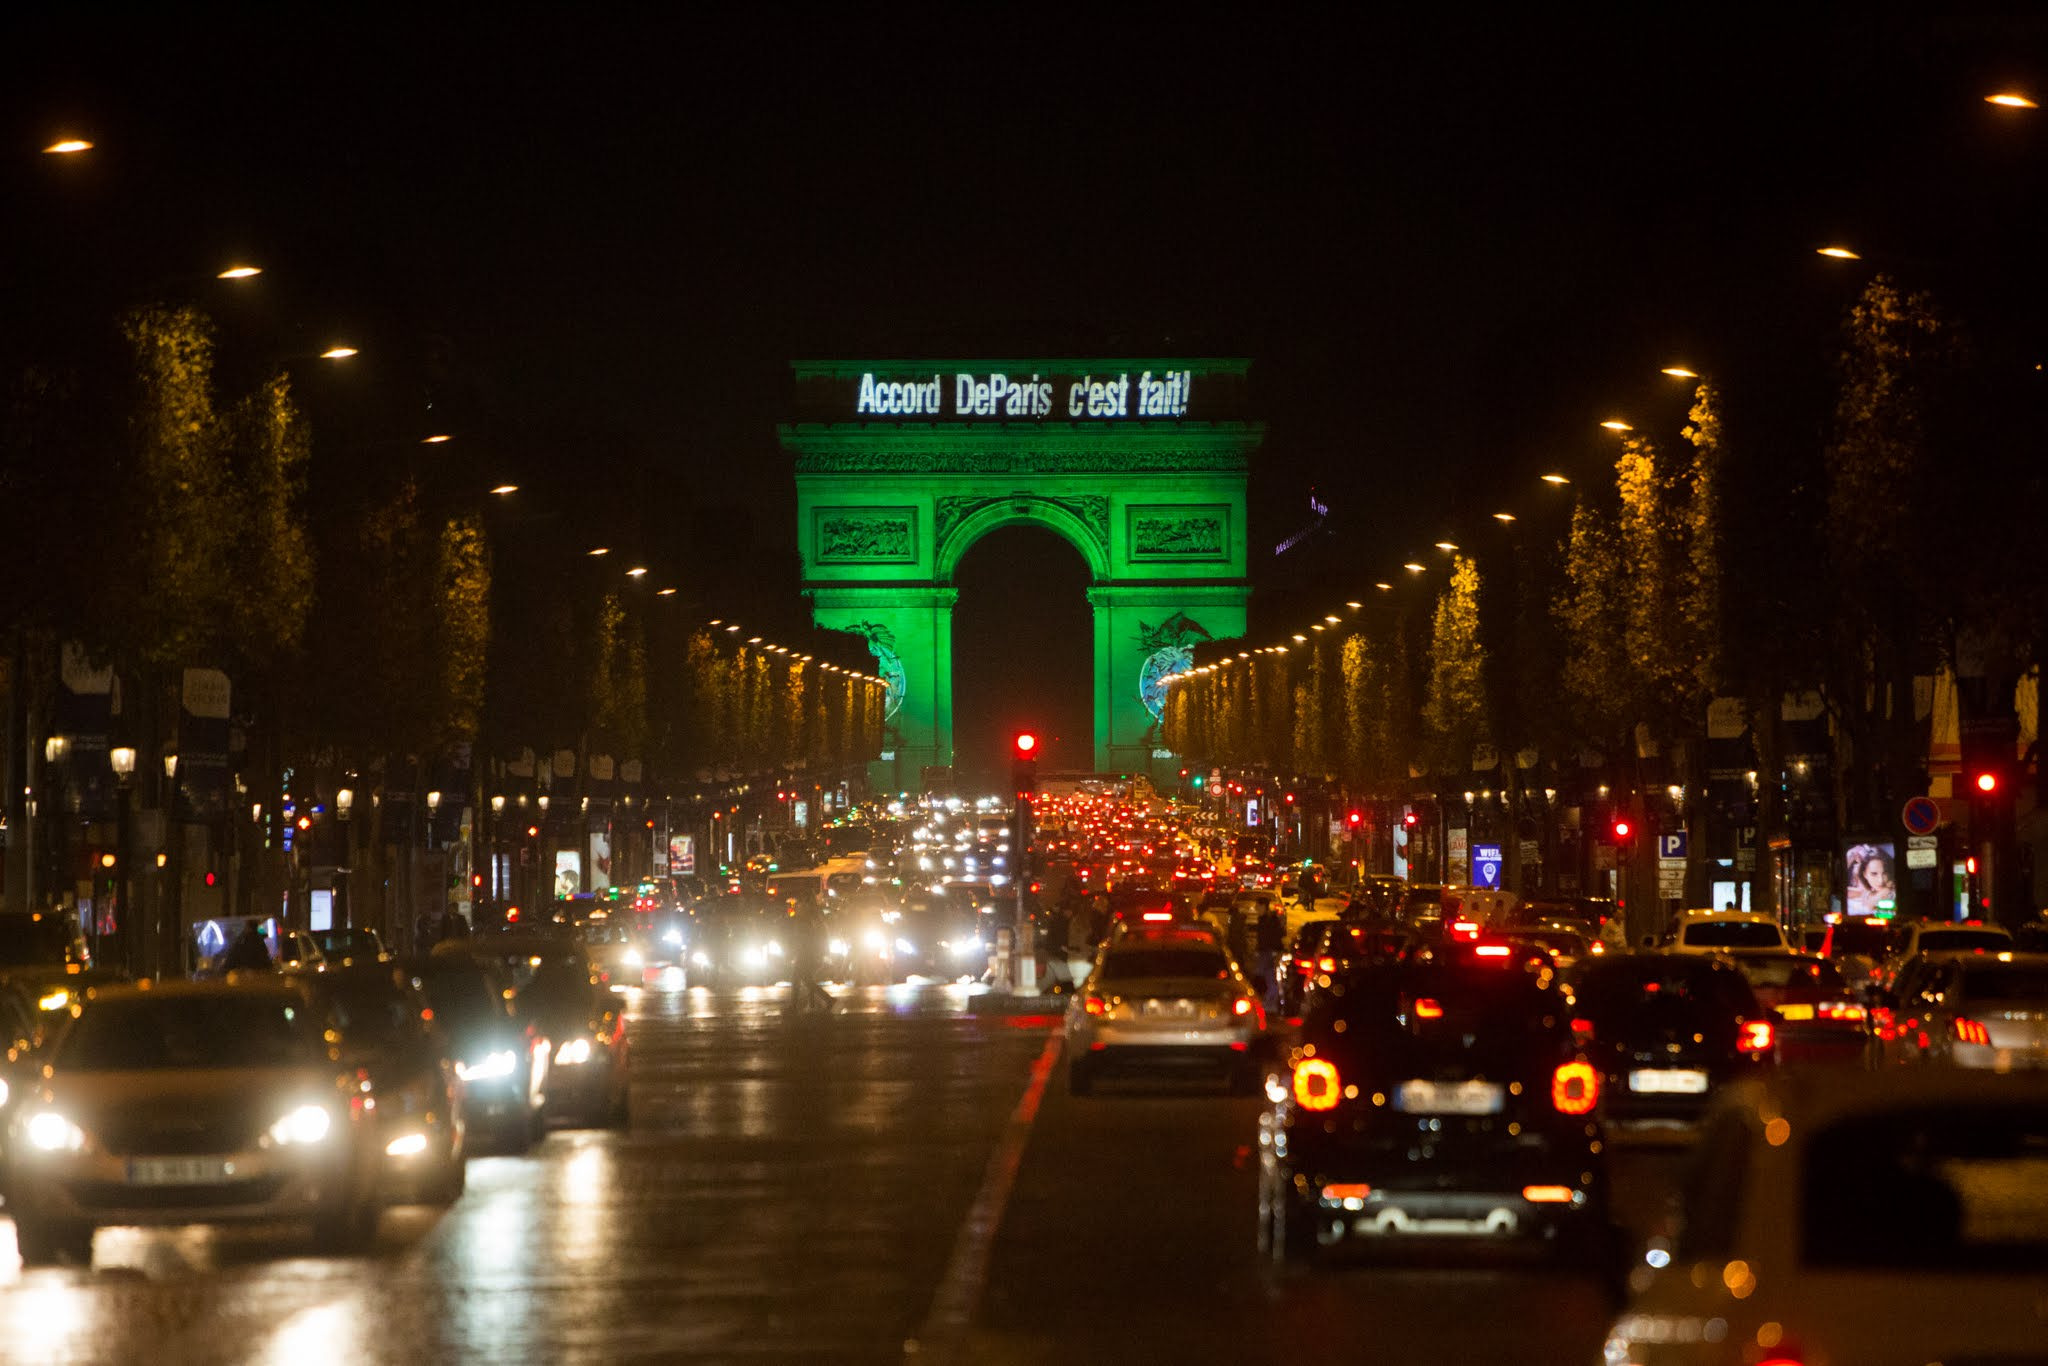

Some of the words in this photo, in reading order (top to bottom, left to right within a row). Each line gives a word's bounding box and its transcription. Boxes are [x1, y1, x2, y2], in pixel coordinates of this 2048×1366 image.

[857, 373, 940, 414] Accord
[956, 373, 1053, 416] DeParis
[1068, 373, 1129, 417] c'est
[1138, 371, 1191, 416] fait!
[1667, 835, 1681, 854] P
